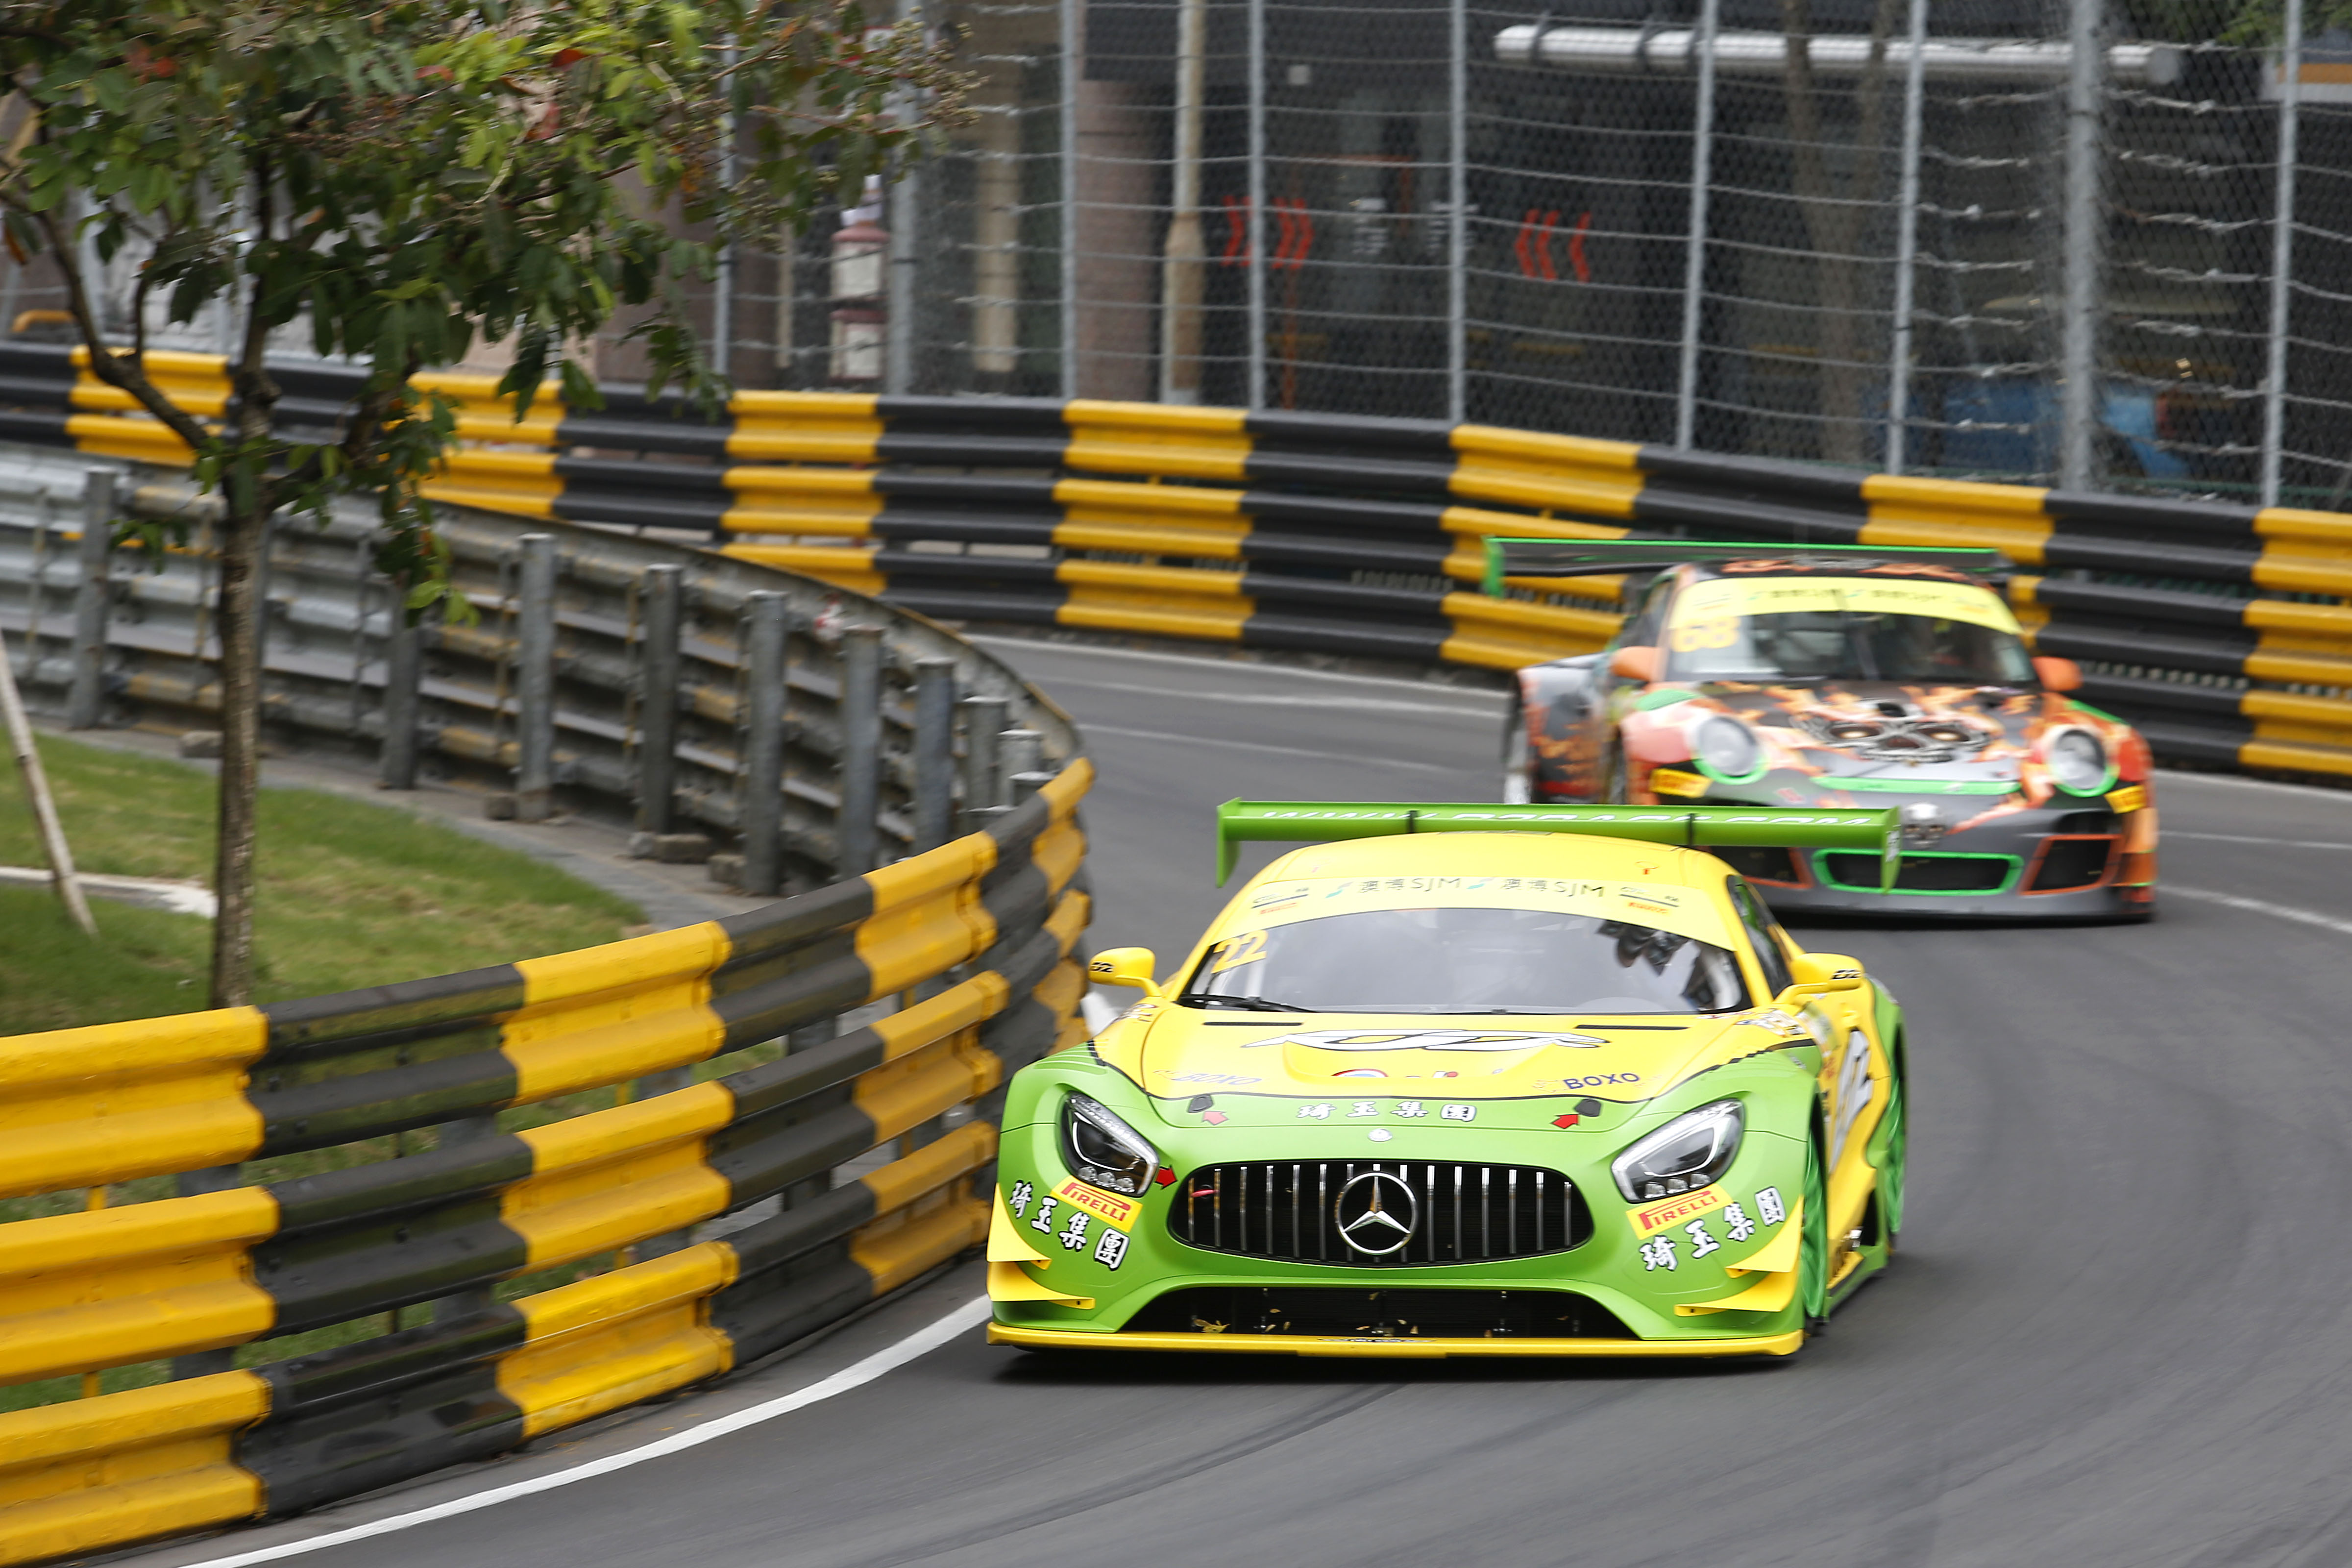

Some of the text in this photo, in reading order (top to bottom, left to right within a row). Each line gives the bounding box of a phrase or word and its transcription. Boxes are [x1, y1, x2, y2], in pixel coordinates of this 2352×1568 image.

[1211, 929, 1268, 974] 22
[1171, 1073, 1263, 1085] BOXO
[1562, 1072, 1640, 1090] BOXO
[1061, 1182, 1131, 1222] PIRELLI
[1638, 1190, 1719, 1230] PIRELLI
